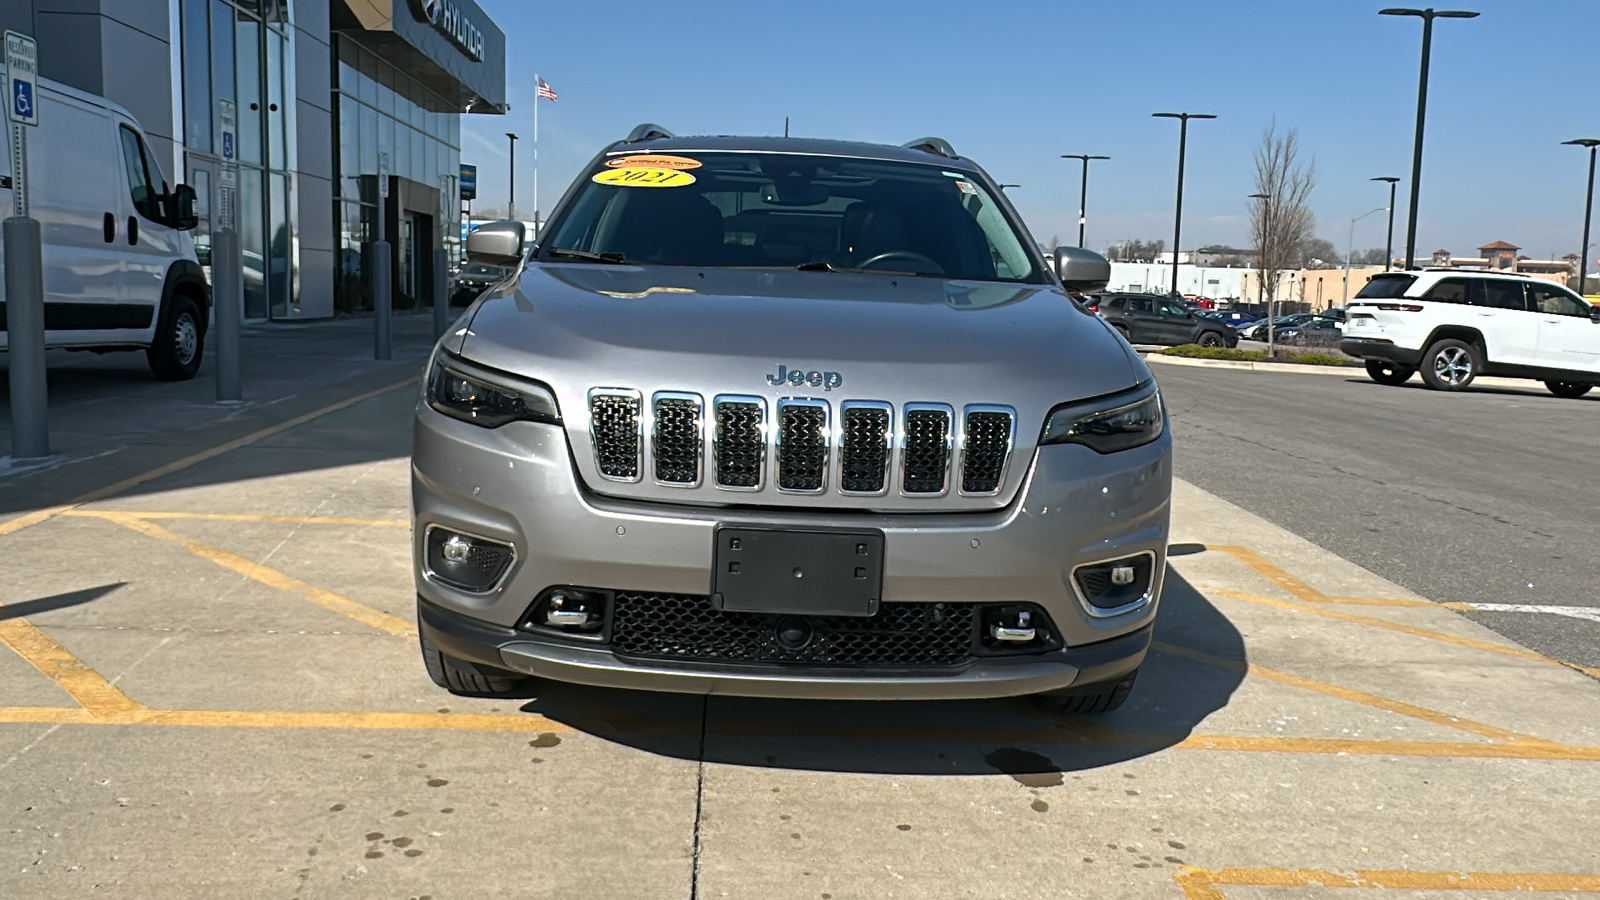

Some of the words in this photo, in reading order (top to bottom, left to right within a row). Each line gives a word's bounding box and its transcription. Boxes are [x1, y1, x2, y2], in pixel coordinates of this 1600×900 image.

[443, 0, 485, 62] HYUNDAI
[9, 55, 35, 74] PARKING
[608, 170, 680, 183] 2021
[766, 364, 843, 391] Jeep
